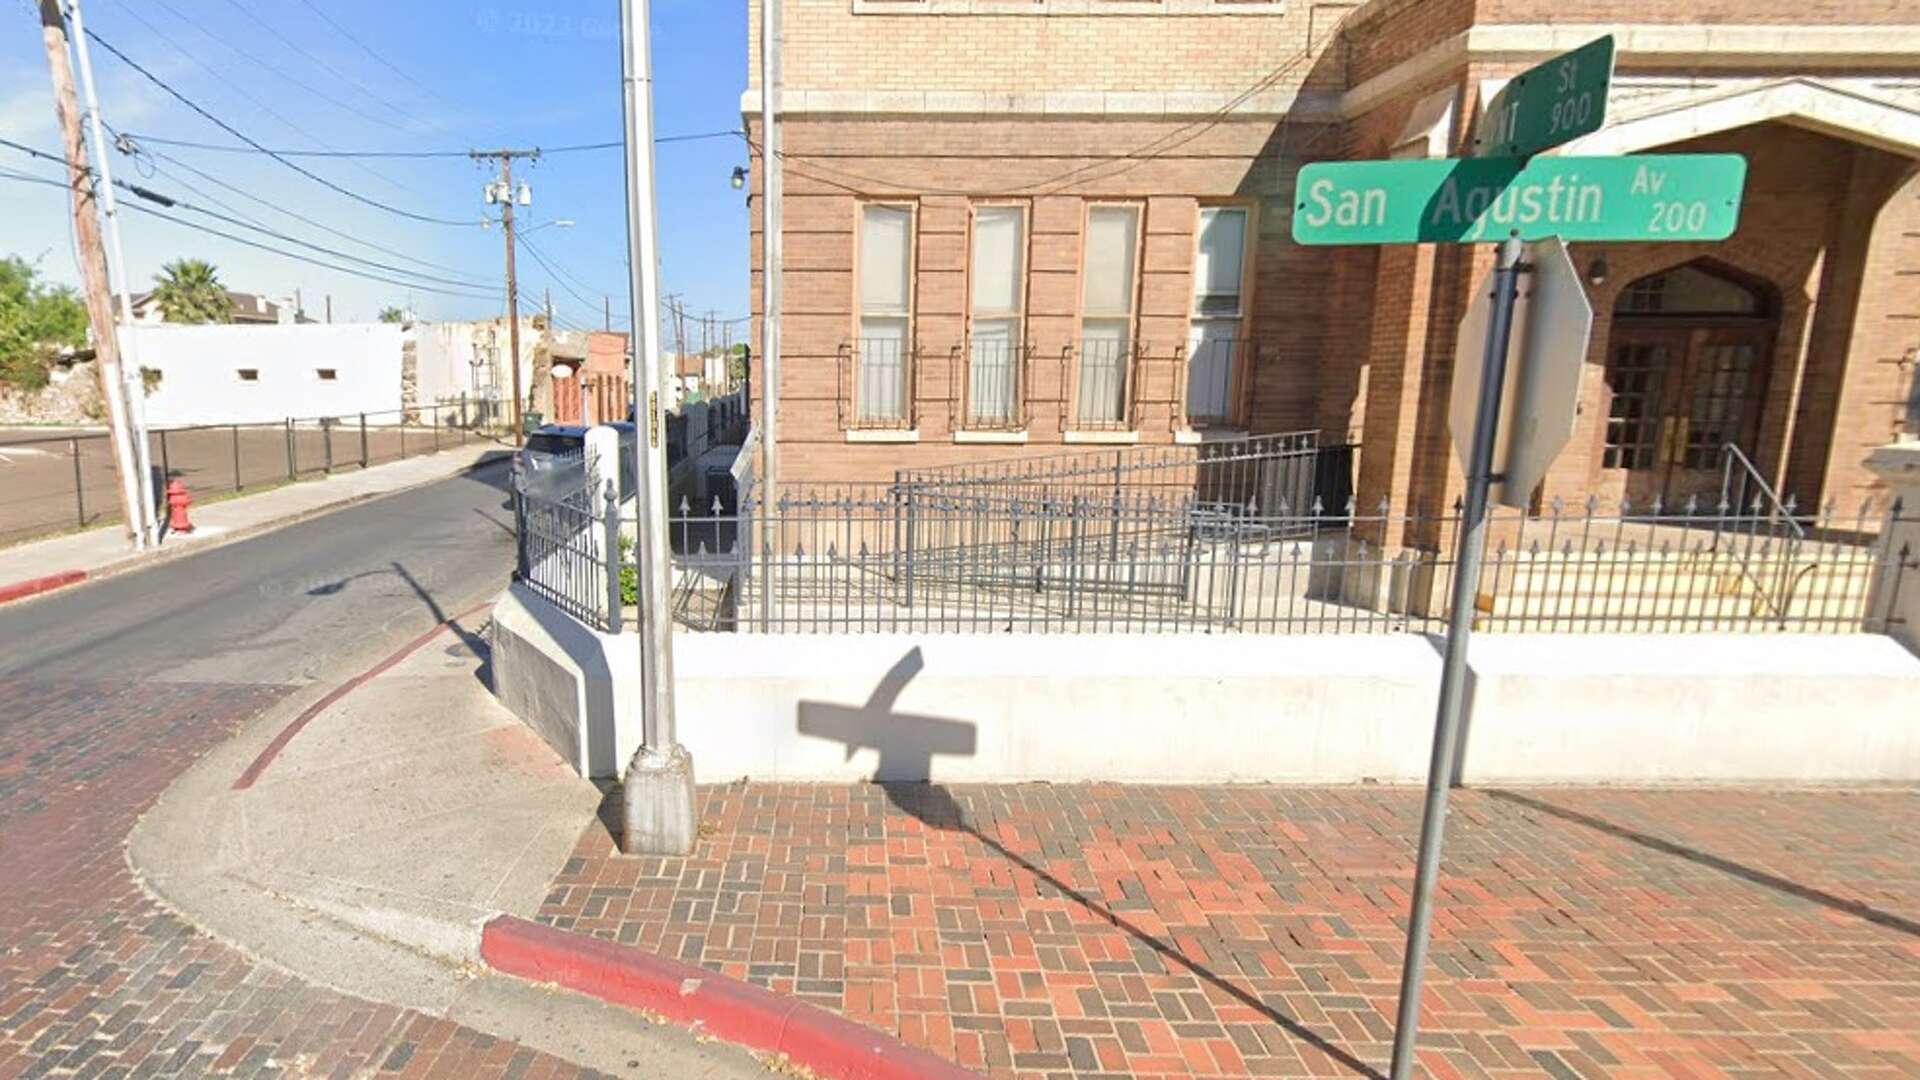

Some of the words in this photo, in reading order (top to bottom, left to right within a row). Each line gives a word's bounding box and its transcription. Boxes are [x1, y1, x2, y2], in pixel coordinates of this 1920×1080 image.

[1556, 57, 1579, 93] St
[1549, 90, 1592, 135] 900
[1630, 163, 1667, 195] Av
[1306, 177, 1388, 227] San
[1431, 174, 1603, 240] Agustin
[1647, 201, 1707, 232] 200
